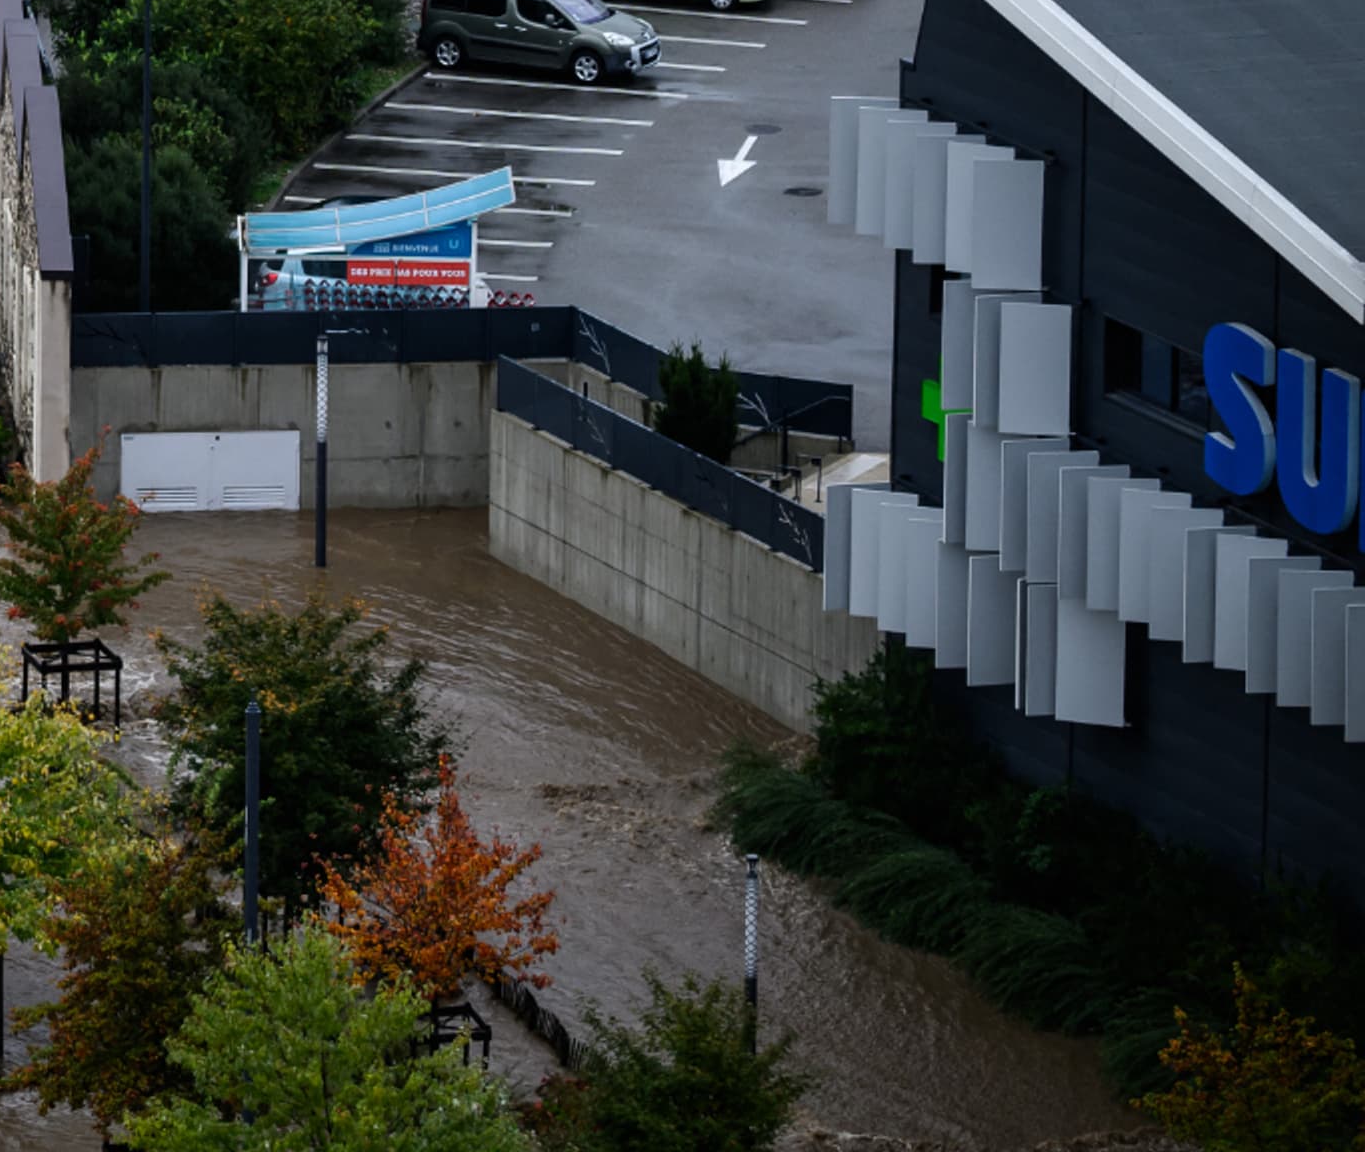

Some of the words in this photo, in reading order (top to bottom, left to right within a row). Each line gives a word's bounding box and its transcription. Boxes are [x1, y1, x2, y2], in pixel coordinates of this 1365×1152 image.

[449, 239, 460, 249] U
[395, 269, 411, 277] AS
[1203, 321, 1365, 553] SU
